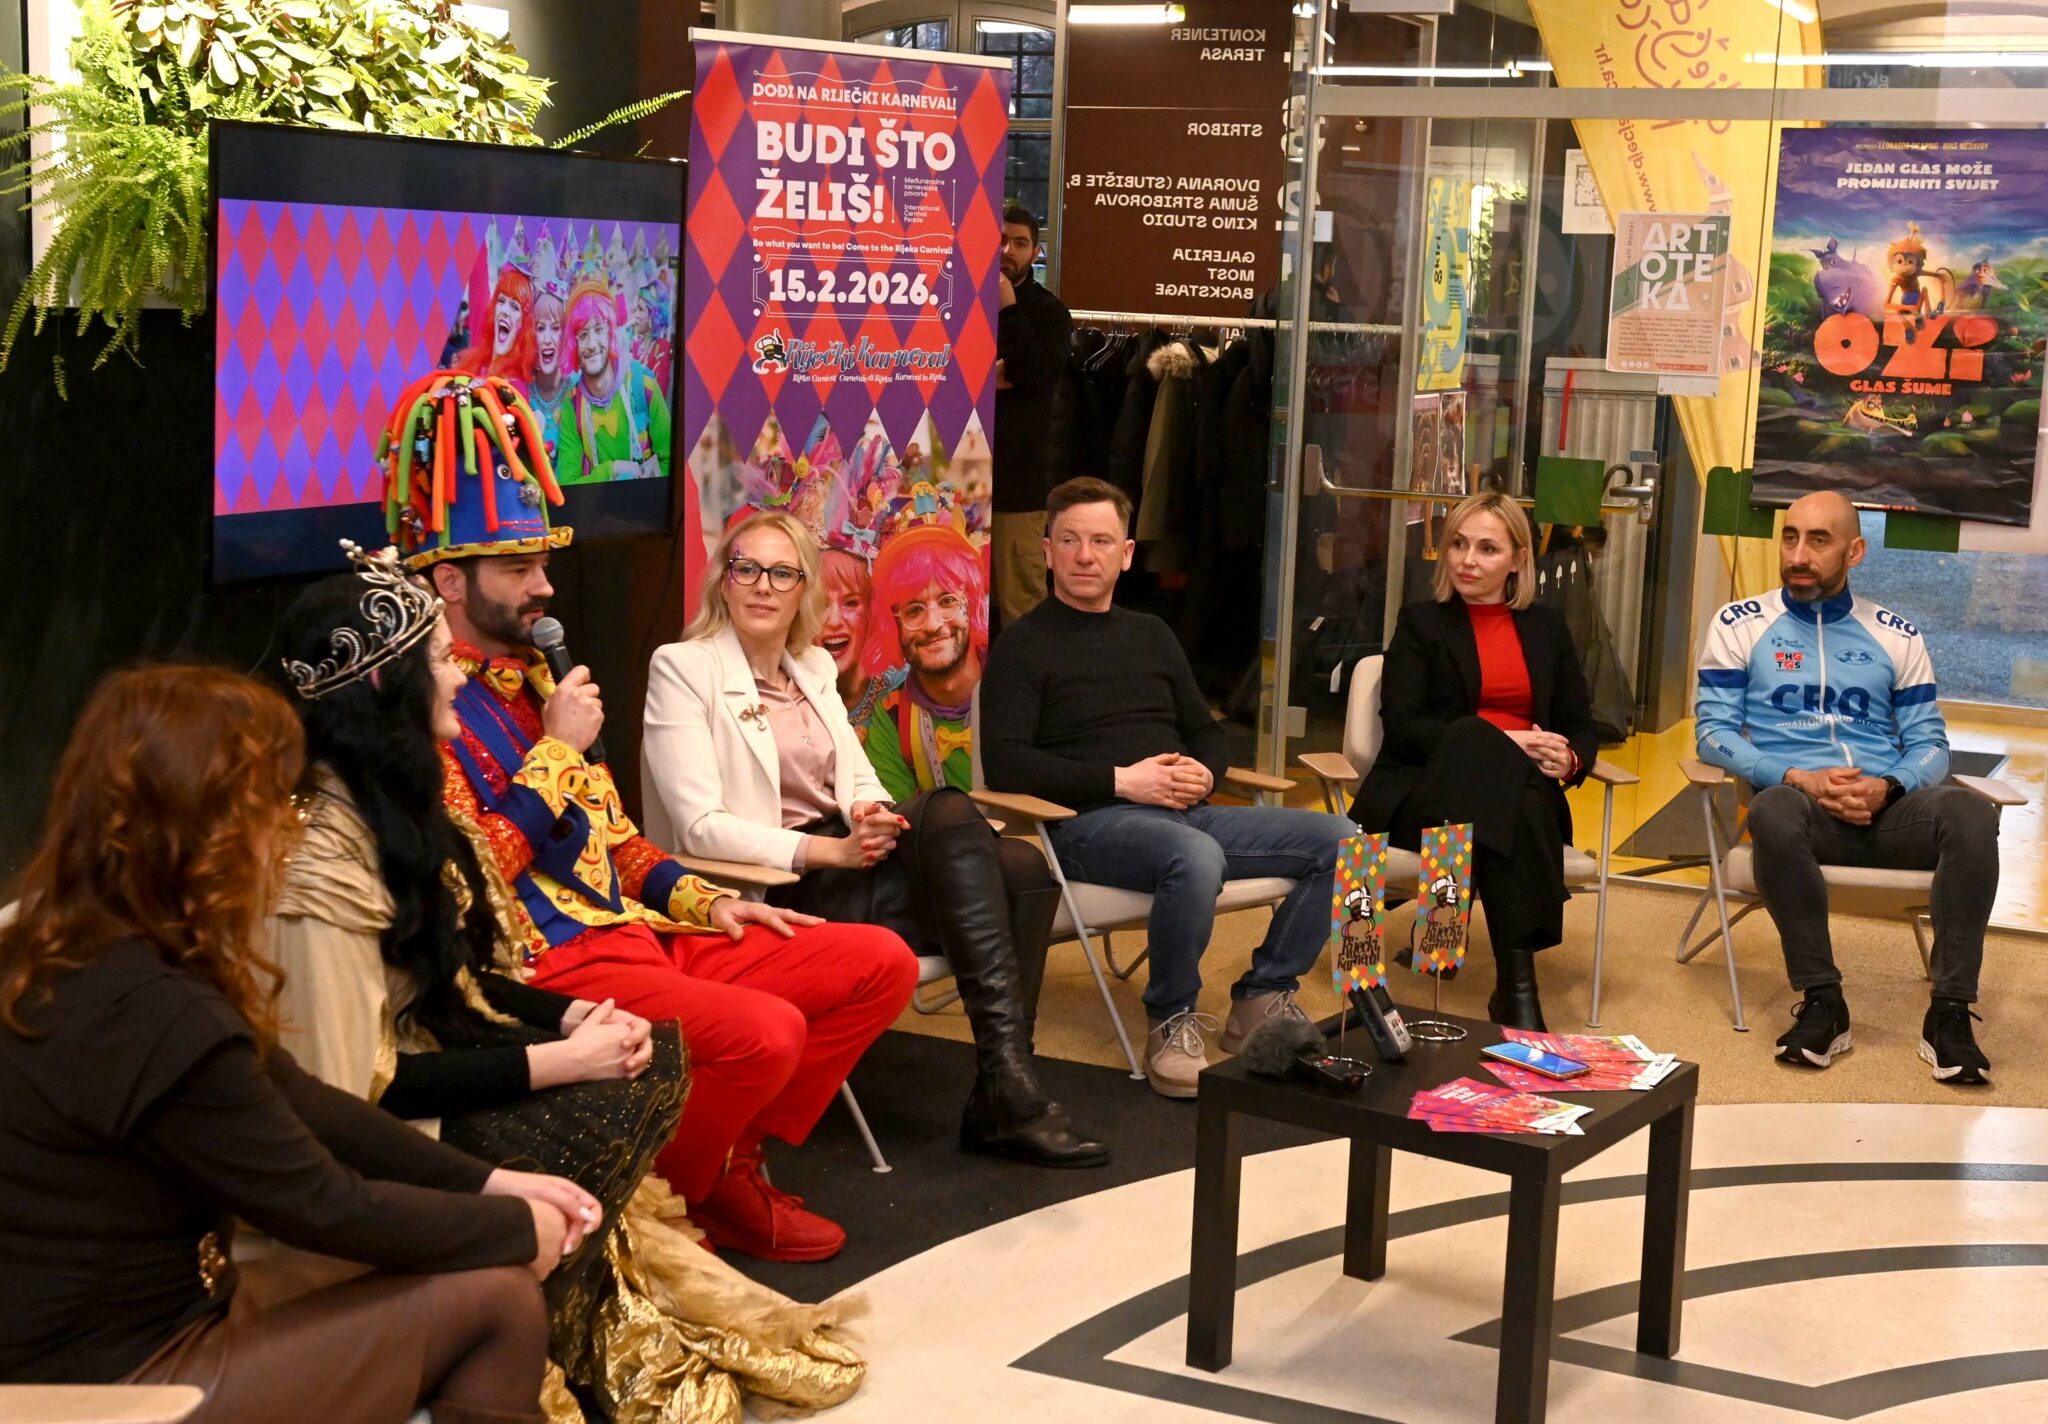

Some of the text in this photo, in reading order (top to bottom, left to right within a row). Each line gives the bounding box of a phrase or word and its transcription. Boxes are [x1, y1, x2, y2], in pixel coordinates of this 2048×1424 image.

[753, 83, 956, 111] DOĐI NA RIJEČKI KARNEVAL!
[757, 118, 956, 171] BUDI ŠTO
[1846, 161, 1993, 175] JEDAN GLAS MOŽE
[755, 168, 884, 224] ŽELIŠ!
[1837, 178, 1999, 190] PROMIJENITI SVIJET
[753, 239, 763, 247] Be
[765, 240, 785, 248] what
[787, 241, 800, 250] you
[822, 242, 831, 250] to
[832, 242, 845, 250] be!
[846, 243, 869, 251] Come
[871, 243, 879, 251] to
[881, 244, 894, 252] the
[895, 244, 918, 254] Rijeka
[920, 246, 953, 254] Carnival!
[1642, 222, 1717, 252] ART
[1640, 252, 1714, 282] OTE
[769, 269, 938, 305] 15.2.2026.
[1639, 281, 1690, 310] KA
[785, 335, 950, 372] Riječki Karneval
[1850, 378, 1952, 396] GLAS ŠUME
[1720, 600, 1761, 625] CRO
[1876, 610, 1919, 637] CRO
[1771, 684, 1870, 719] CRO
